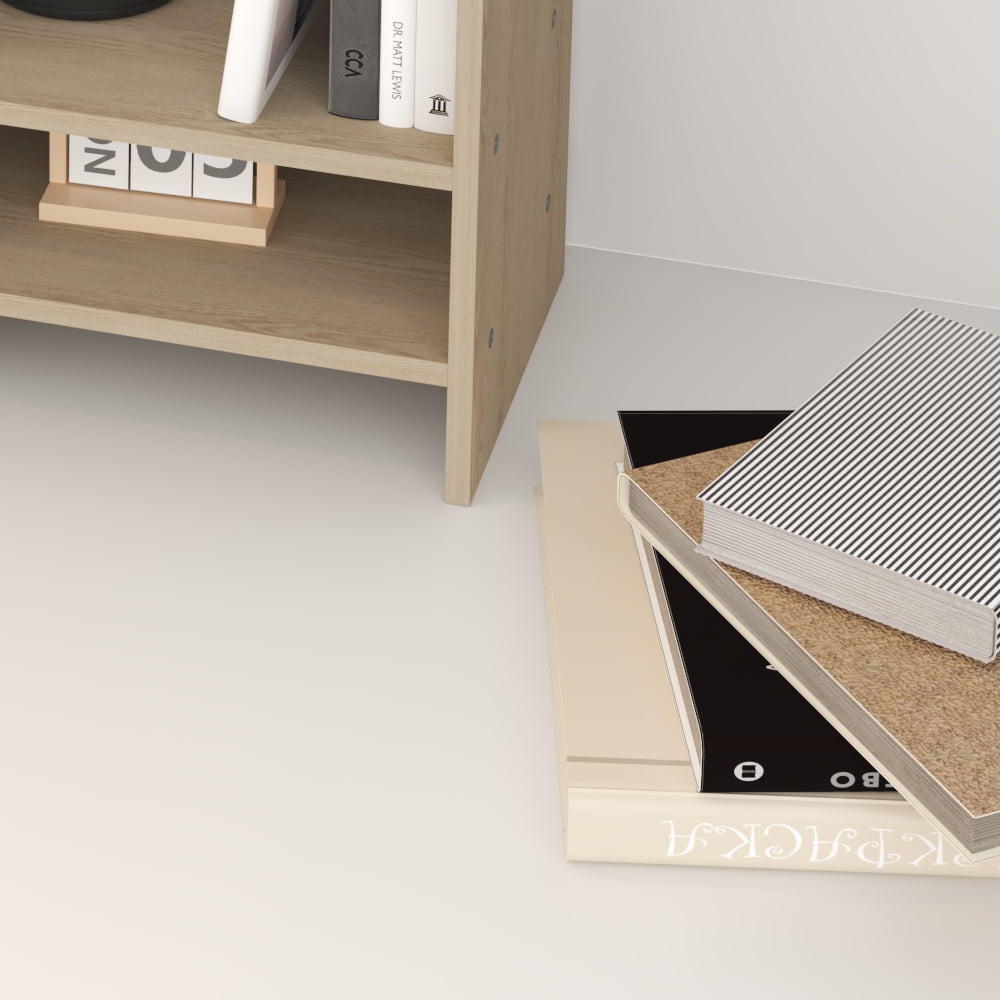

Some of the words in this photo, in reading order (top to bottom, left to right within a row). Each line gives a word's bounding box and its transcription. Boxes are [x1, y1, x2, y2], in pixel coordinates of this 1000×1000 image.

[392, 20, 404, 38] DR.
[392, 39, 404, 68] MATT
[391, 69, 403, 101] LEWIS
